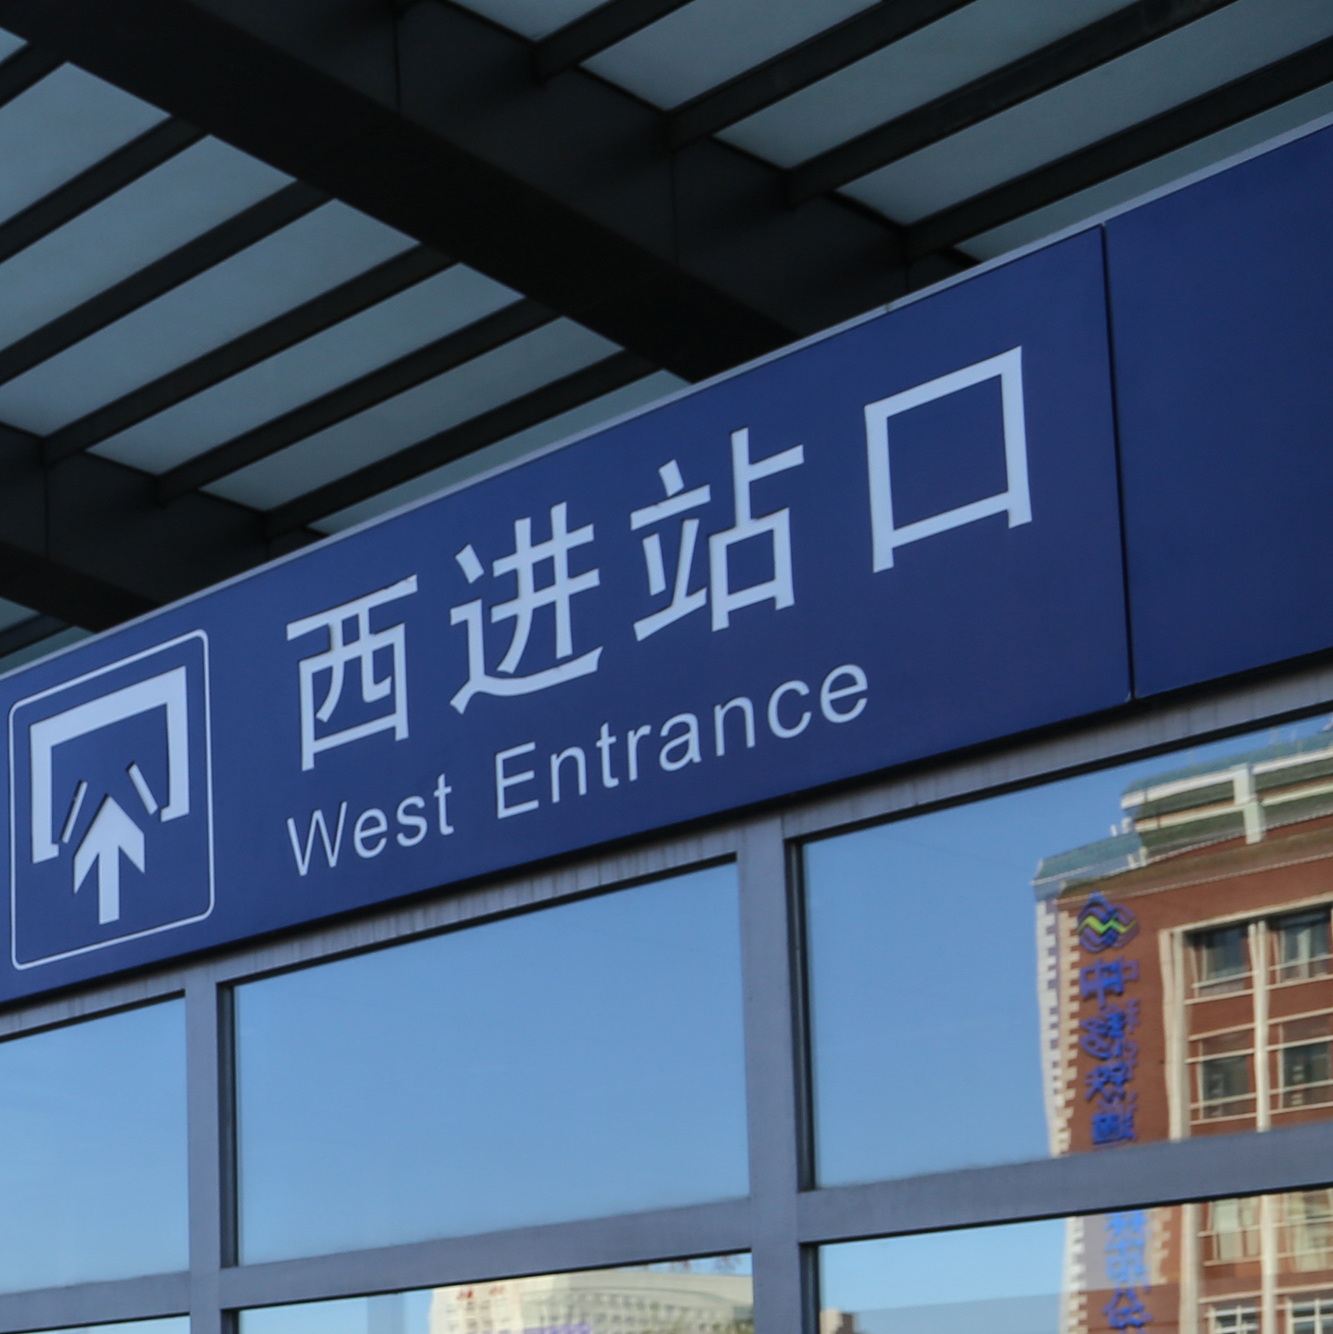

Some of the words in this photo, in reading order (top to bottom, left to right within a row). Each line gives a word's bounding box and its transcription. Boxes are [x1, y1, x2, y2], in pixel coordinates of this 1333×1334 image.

[286, 345, 1033, 771] 西进站口
[287, 773, 454, 876] West
[495, 662, 869, 819] Entrance
